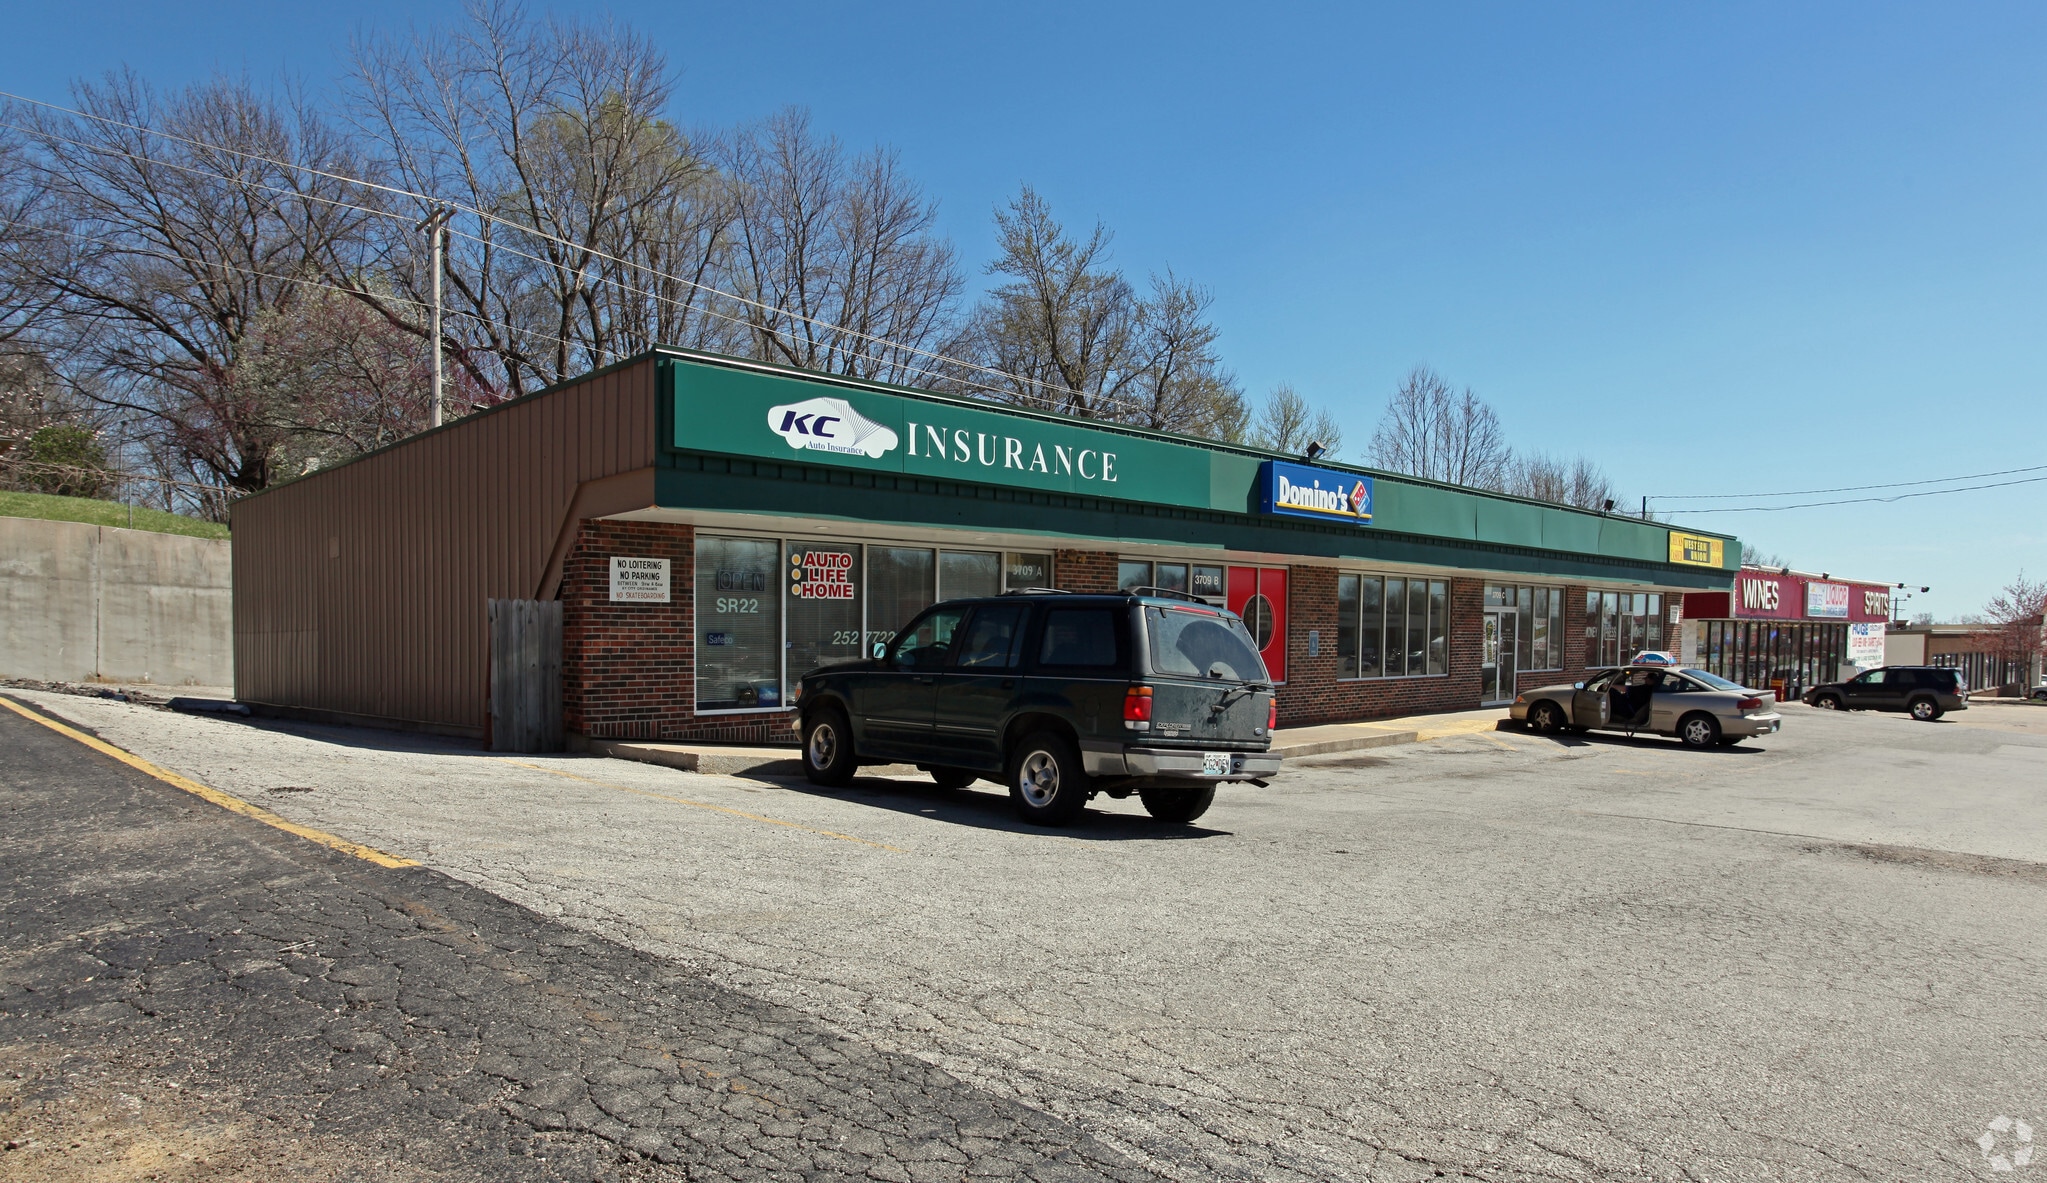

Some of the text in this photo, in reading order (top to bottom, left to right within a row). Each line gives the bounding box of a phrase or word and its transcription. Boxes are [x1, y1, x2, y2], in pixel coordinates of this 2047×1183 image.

[779, 410, 841, 438] KC
[807, 440, 863, 455] Auto Insurance
[907, 422, 1118, 483] INSURANCE
[1278, 475, 1348, 512] Domino's
[1684, 539, 1708, 552] WESTERN
[802, 551, 853, 568] AUTO
[1690, 550, 1708, 563] UNION
[617, 559, 662, 570] NO LOITERING
[1012, 565, 1042, 577] 3709 A
[620, 571, 660, 580] NO PARKING
[720, 572, 764, 590] OPEN
[808, 568, 848, 583] LIFE
[1194, 574, 1219, 586] 3709 B
[626, 592, 666, 600] SKATEBOARDING
[801, 582, 854, 599] HOME
[1742, 578, 1780, 610] WINES
[1826, 585, 1848, 606] LIQUOR
[716, 597, 759, 614] SR22
[1864, 591, 1889, 616] SPIRITS
[1852, 623, 1869, 636] HUGE
[708, 634, 734, 644] Safeco
[832, 631, 859, 645] 252
